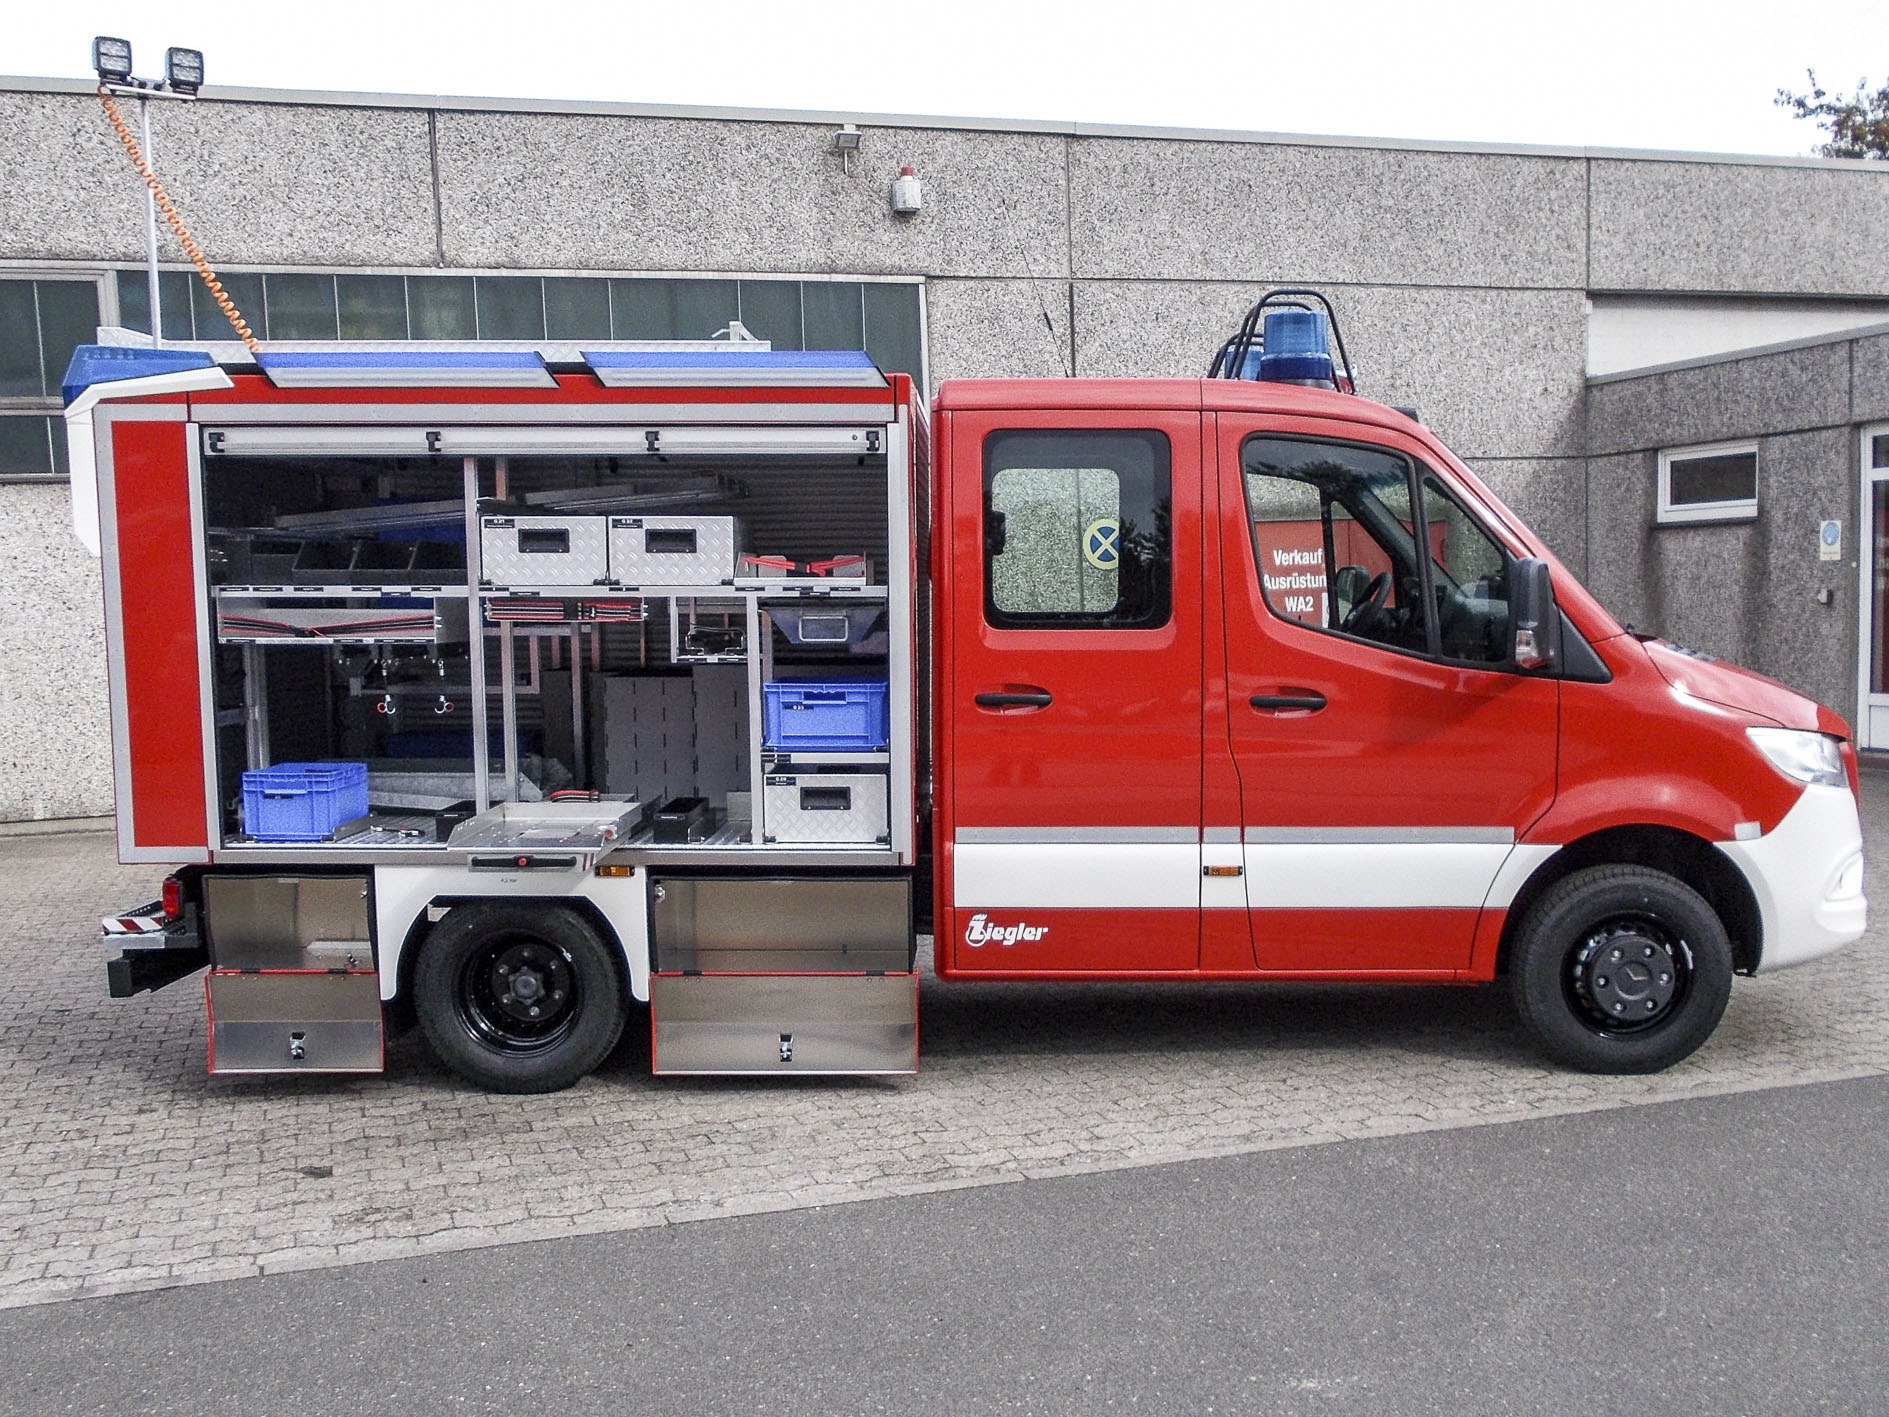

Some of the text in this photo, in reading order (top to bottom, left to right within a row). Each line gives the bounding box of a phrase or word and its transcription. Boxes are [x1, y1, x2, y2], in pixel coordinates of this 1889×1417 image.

[1273, 548, 1322, 565] Verkauf
[1285, 596, 1314, 612] WA2
[965, 913, 1049, 947] Ziegler
